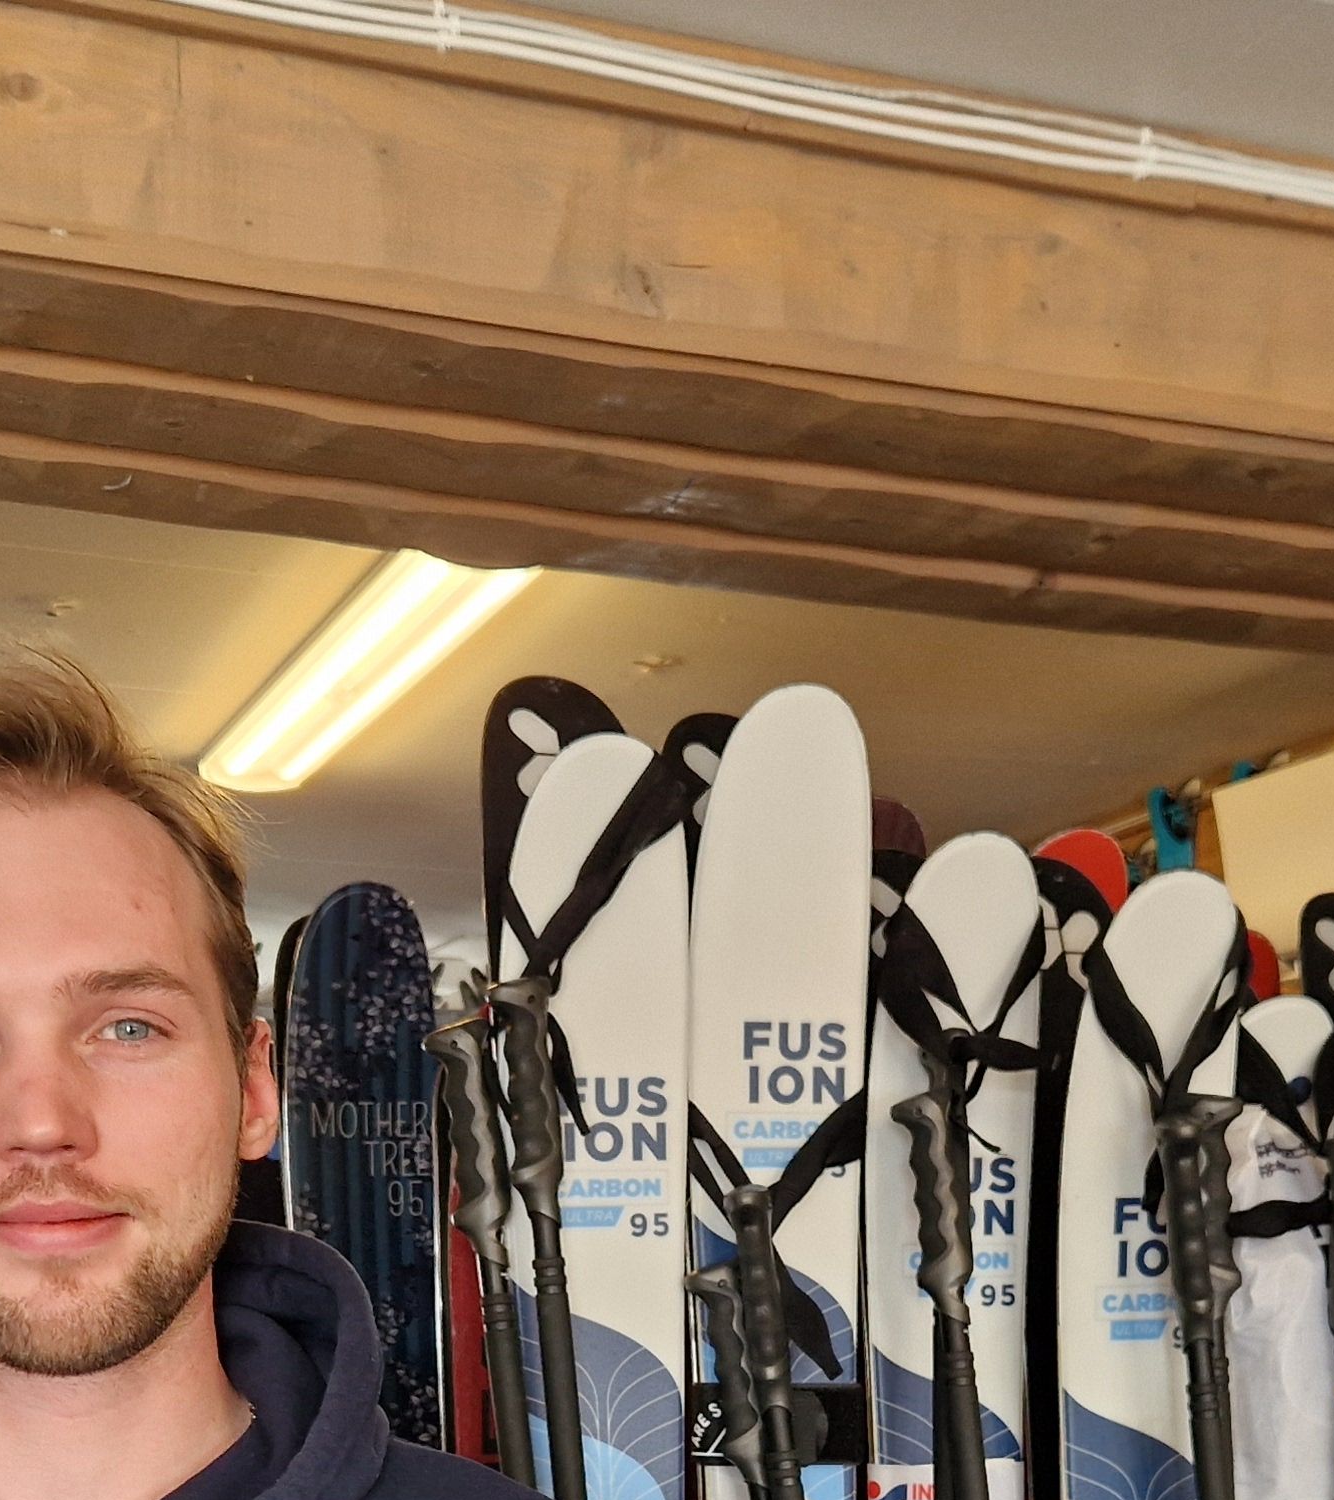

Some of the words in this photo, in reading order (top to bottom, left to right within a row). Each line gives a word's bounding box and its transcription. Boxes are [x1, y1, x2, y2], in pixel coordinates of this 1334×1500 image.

[743, 1021, 847, 1062] FUS
[749, 1065, 845, 1105] ION
[310, 1101, 431, 1139] MOTHER
[363, 1140, 432, 1177] TREE
[564, 1122, 667, 1162] ION
[388, 1180, 424, 1217] 95
[559, 1178, 662, 1198] ARBON
[630, 1213, 670, 1237] 95
[981, 1284, 1015, 1307] 95
